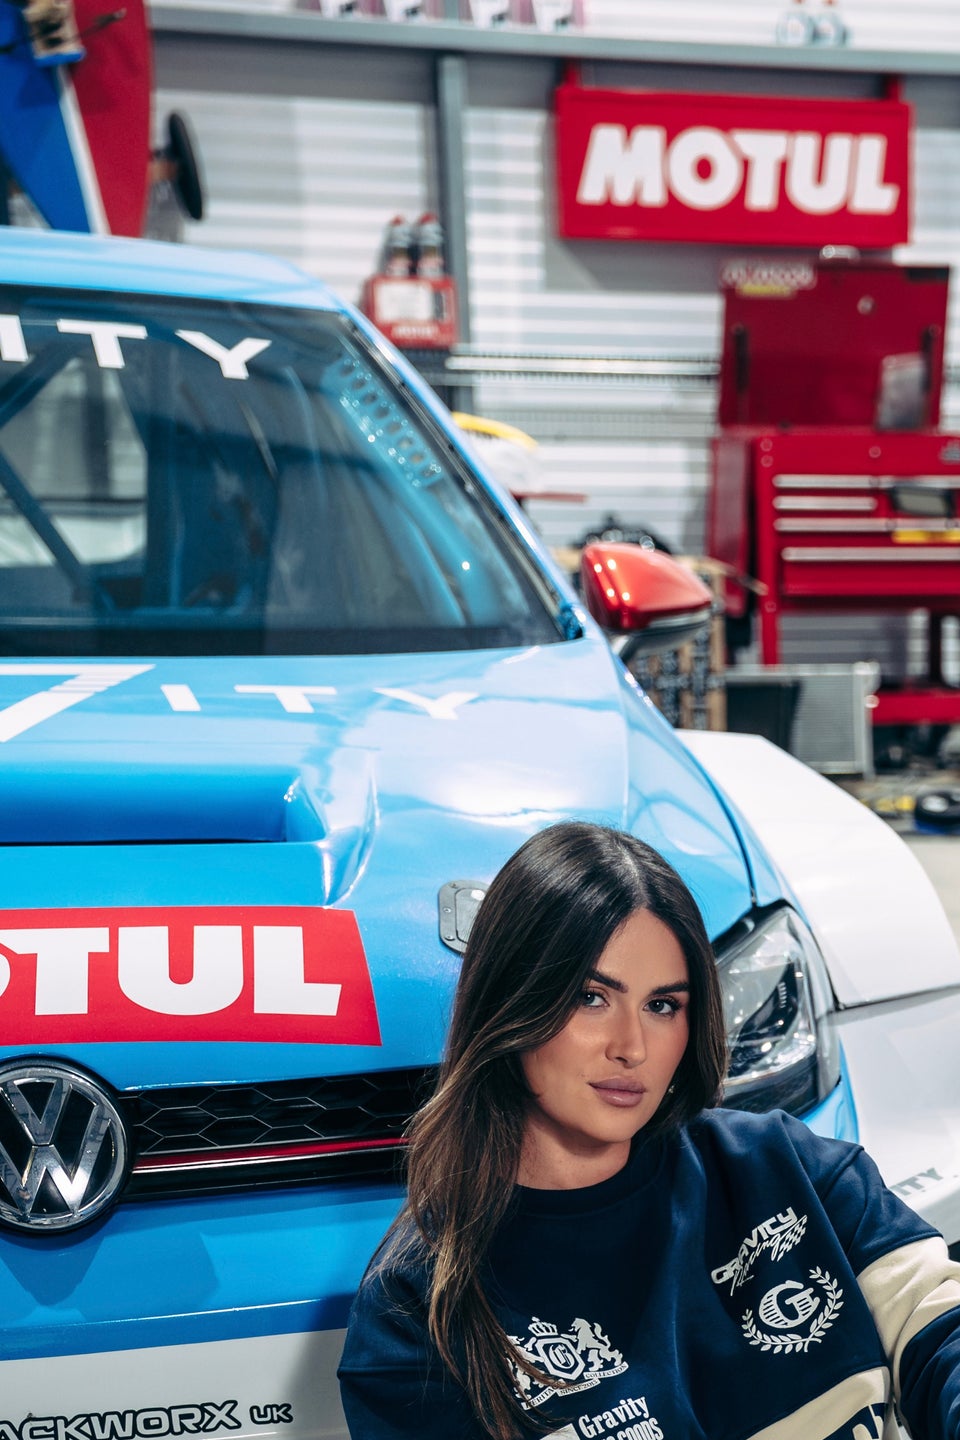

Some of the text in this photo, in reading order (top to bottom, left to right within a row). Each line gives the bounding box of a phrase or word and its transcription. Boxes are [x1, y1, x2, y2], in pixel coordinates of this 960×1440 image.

[577, 123, 900, 214] MOTUL
[0, 924, 342, 1016] TUL
[711, 1206, 798, 1284] GRAVITY
[250, 1403, 293, 1425] UK
[578, 1396, 650, 1439] Gravity
